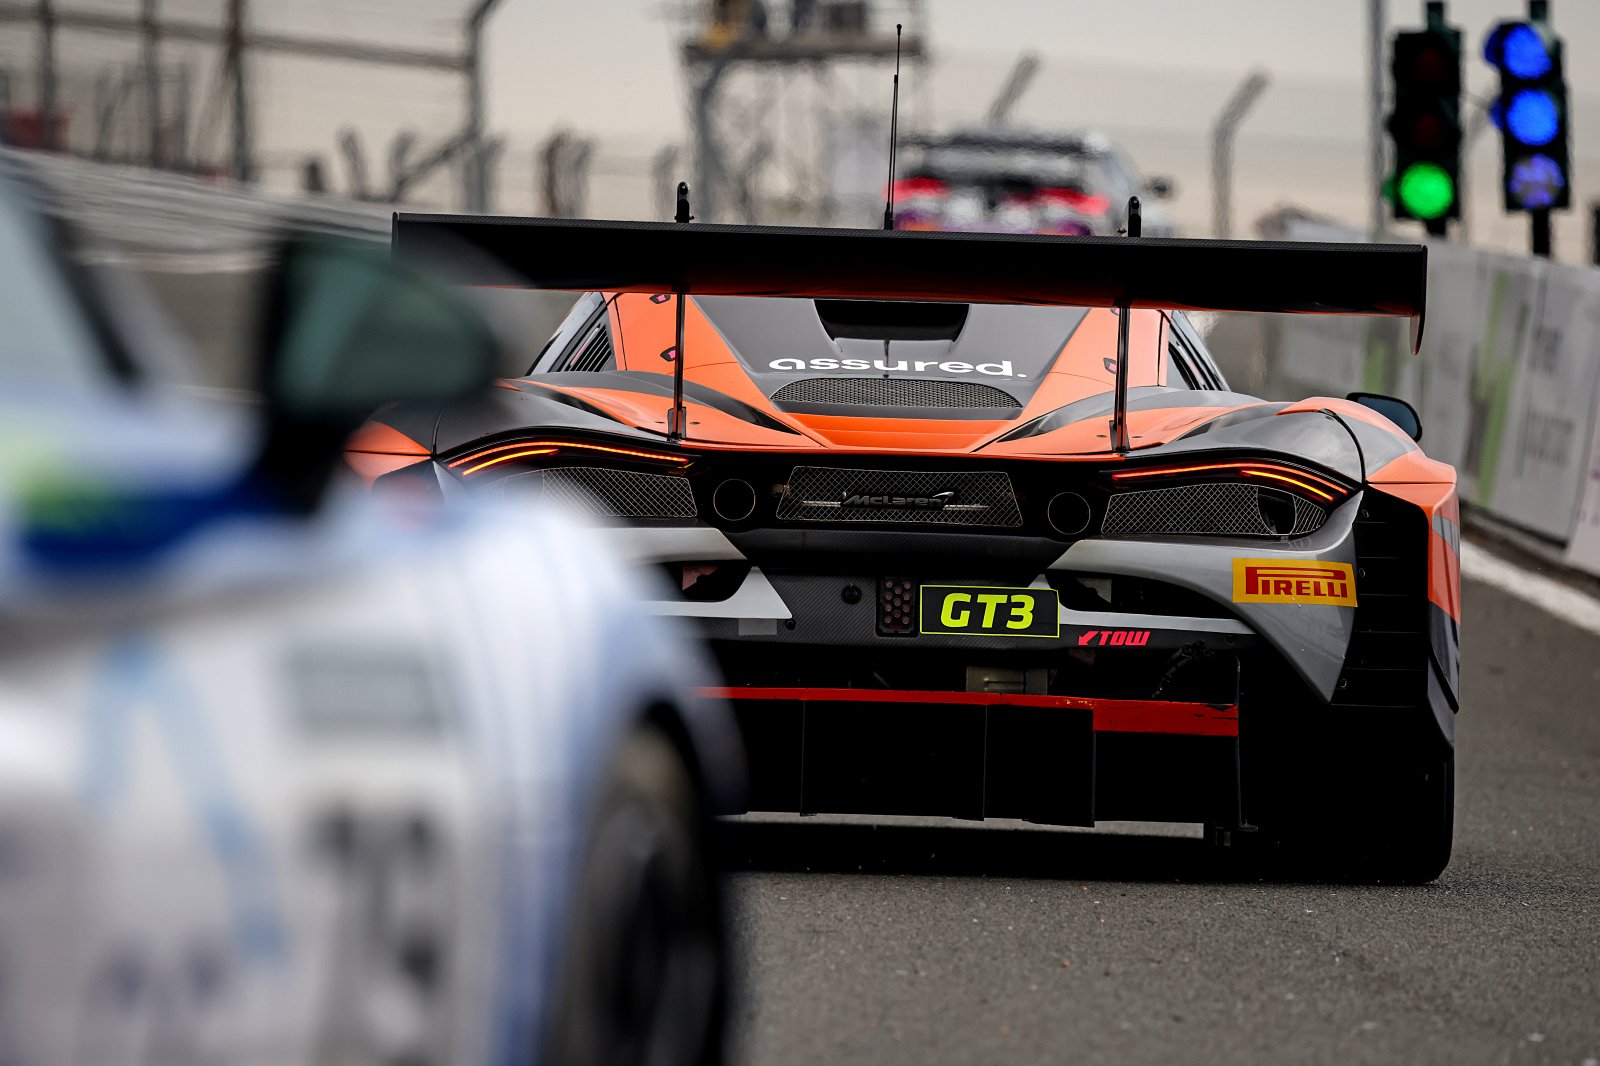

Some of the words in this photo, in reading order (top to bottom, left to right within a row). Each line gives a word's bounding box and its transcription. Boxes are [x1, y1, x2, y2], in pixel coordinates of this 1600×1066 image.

[769, 358, 1027, 378] assured.
[843, 495, 942, 506] McLaren
[1244, 566, 1348, 599] PIRELLI
[940, 592, 1035, 629] GT3
[1097, 631, 1151, 647] TOW
